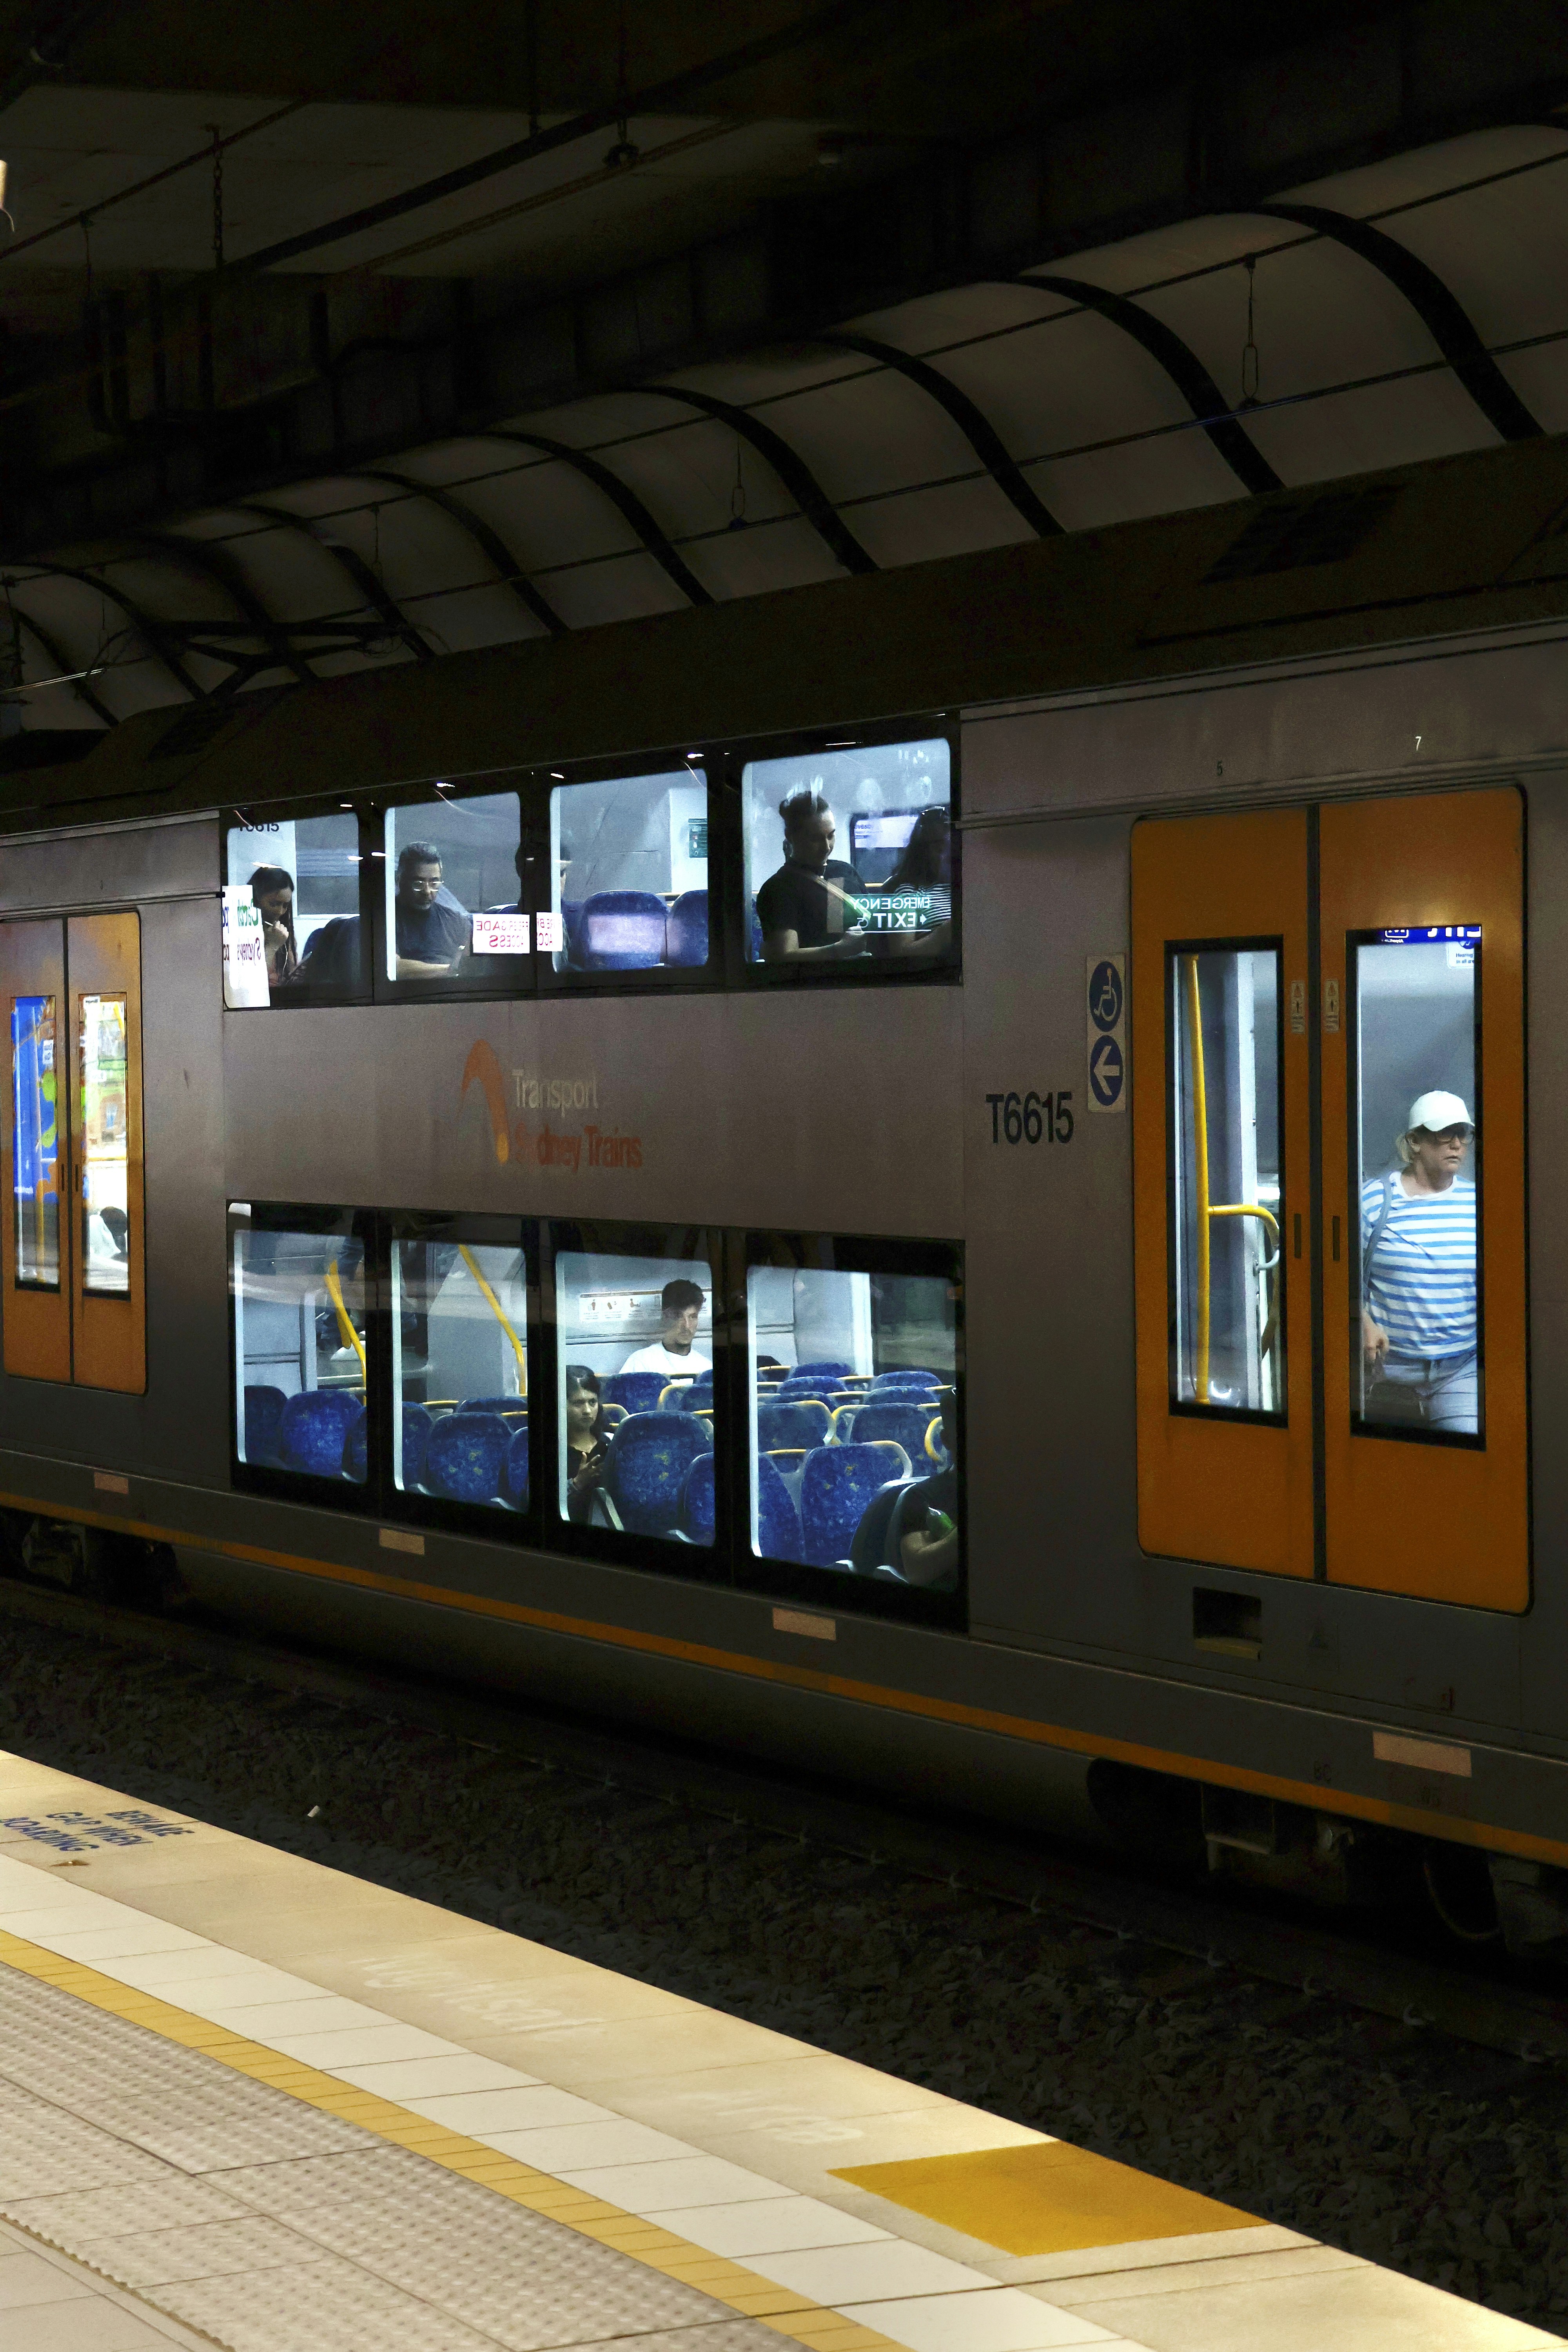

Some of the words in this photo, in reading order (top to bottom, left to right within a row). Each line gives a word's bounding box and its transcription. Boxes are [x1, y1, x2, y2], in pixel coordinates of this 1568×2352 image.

[512, 1069, 599, 1118] Transport
[985, 1091, 1074, 1144] T6615
[584, 1125, 642, 1169] Trains
[45, 1811, 102, 1825] GAP
[83, 1825, 154, 1846] WHEN
[105, 1810, 195, 1837] BEWARE
